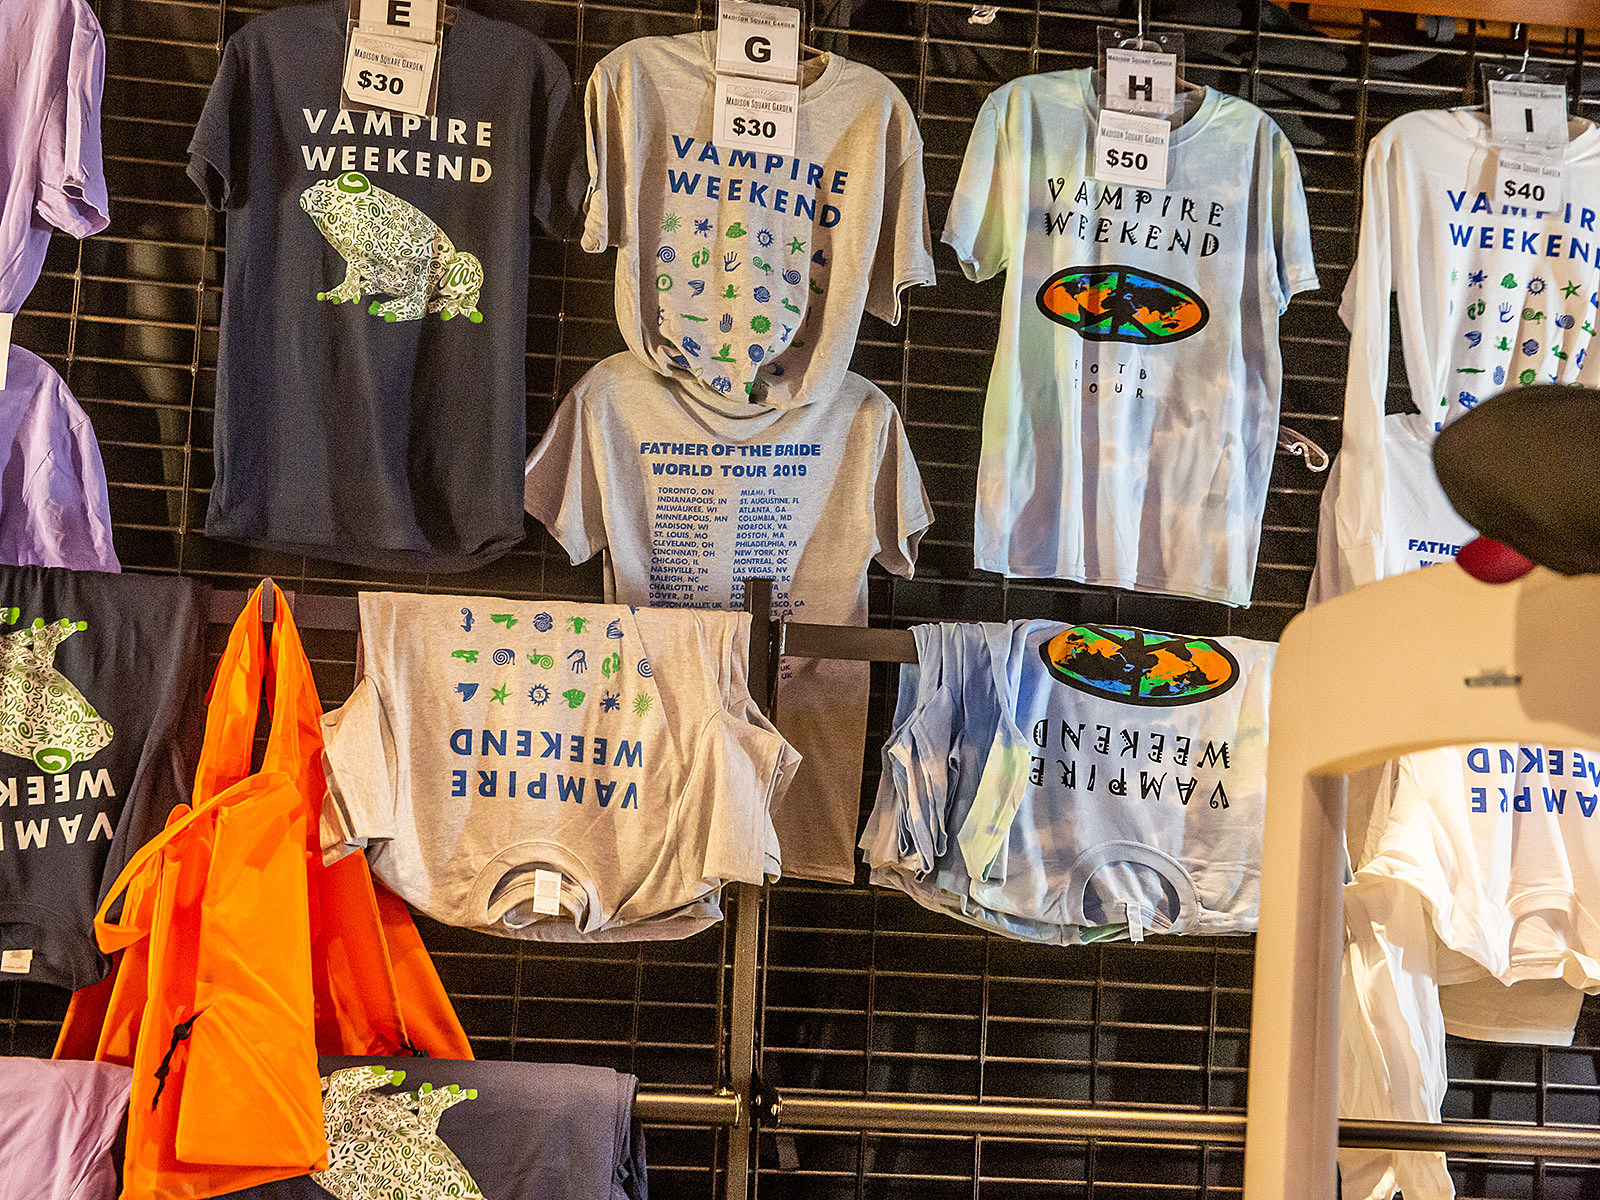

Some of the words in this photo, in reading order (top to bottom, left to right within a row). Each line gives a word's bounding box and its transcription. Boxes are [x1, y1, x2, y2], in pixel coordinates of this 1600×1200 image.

[386, 0, 411, 27] E
[744, 36, 771, 63] G
[357, 69, 404, 95] $30
[1129, 75, 1152, 102] H
[302, 108, 493, 147] VAMPIRE
[732, 117, 776, 138] $30
[1525, 108, 1534, 132] I
[301, 145, 493, 183] WEEKEND
[671, 135, 849, 195] VAMPIRE
[1106, 148, 1148, 170] $50
[667, 169, 841, 228] WEEKEND
[1047, 177, 1224, 227] VAMPIRE
[1504, 180, 1545, 202] $40
[1045, 211, 1219, 257] WEEKEND
[1449, 223, 1600, 269] WEEKEN
[640, 442, 708, 456] FATHER
[711, 444, 735, 456] OF
[737, 445, 772, 457] THE
[774, 444, 821, 456] BRIDE
[652, 463, 712, 477] WORLD
[720, 464, 767, 477] TOUR
[772, 464, 807, 477] 2019
[1408, 538, 1461, 556] FATHE
[450, 728, 643, 768] WEEKEND
[1033, 719, 1230, 769] WEEKEND
[451, 770, 639, 810] VAMPIRE
[1029, 756, 1230, 809] VAMPIRE
[0, 811, 113, 850] VAM
